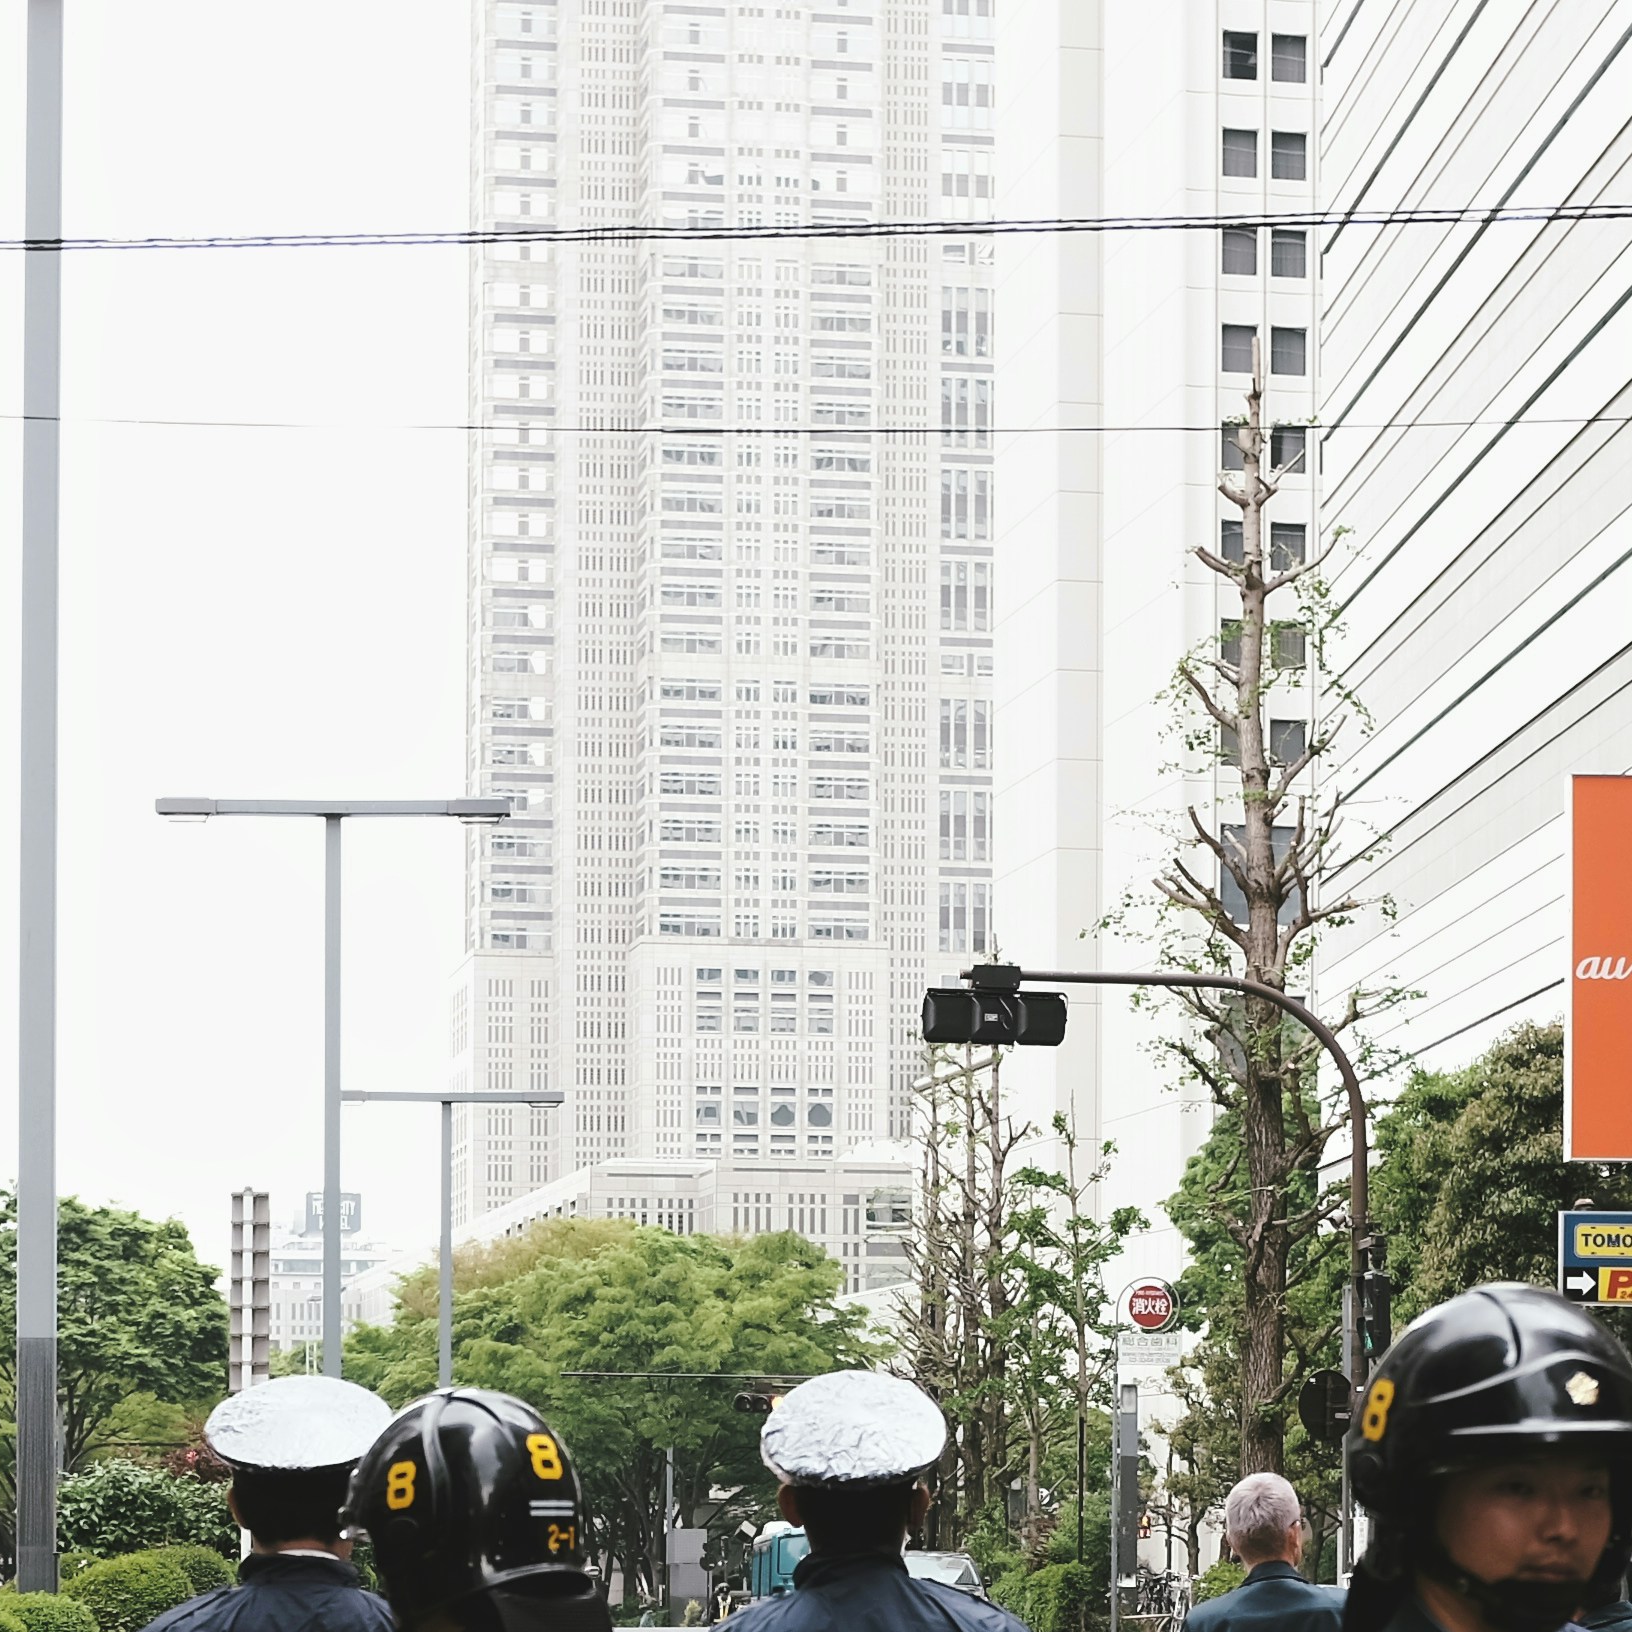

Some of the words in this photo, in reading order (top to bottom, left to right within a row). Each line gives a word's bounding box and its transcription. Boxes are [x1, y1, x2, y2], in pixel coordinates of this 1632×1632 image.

[1132, 1297, 1168, 1315] 消火栓
[1361, 1378, 1395, 1442] 8
[525, 1432, 564, 1481] 8
[386, 1460, 417, 1510] 8
[547, 1524, 575, 1552] 2-1
